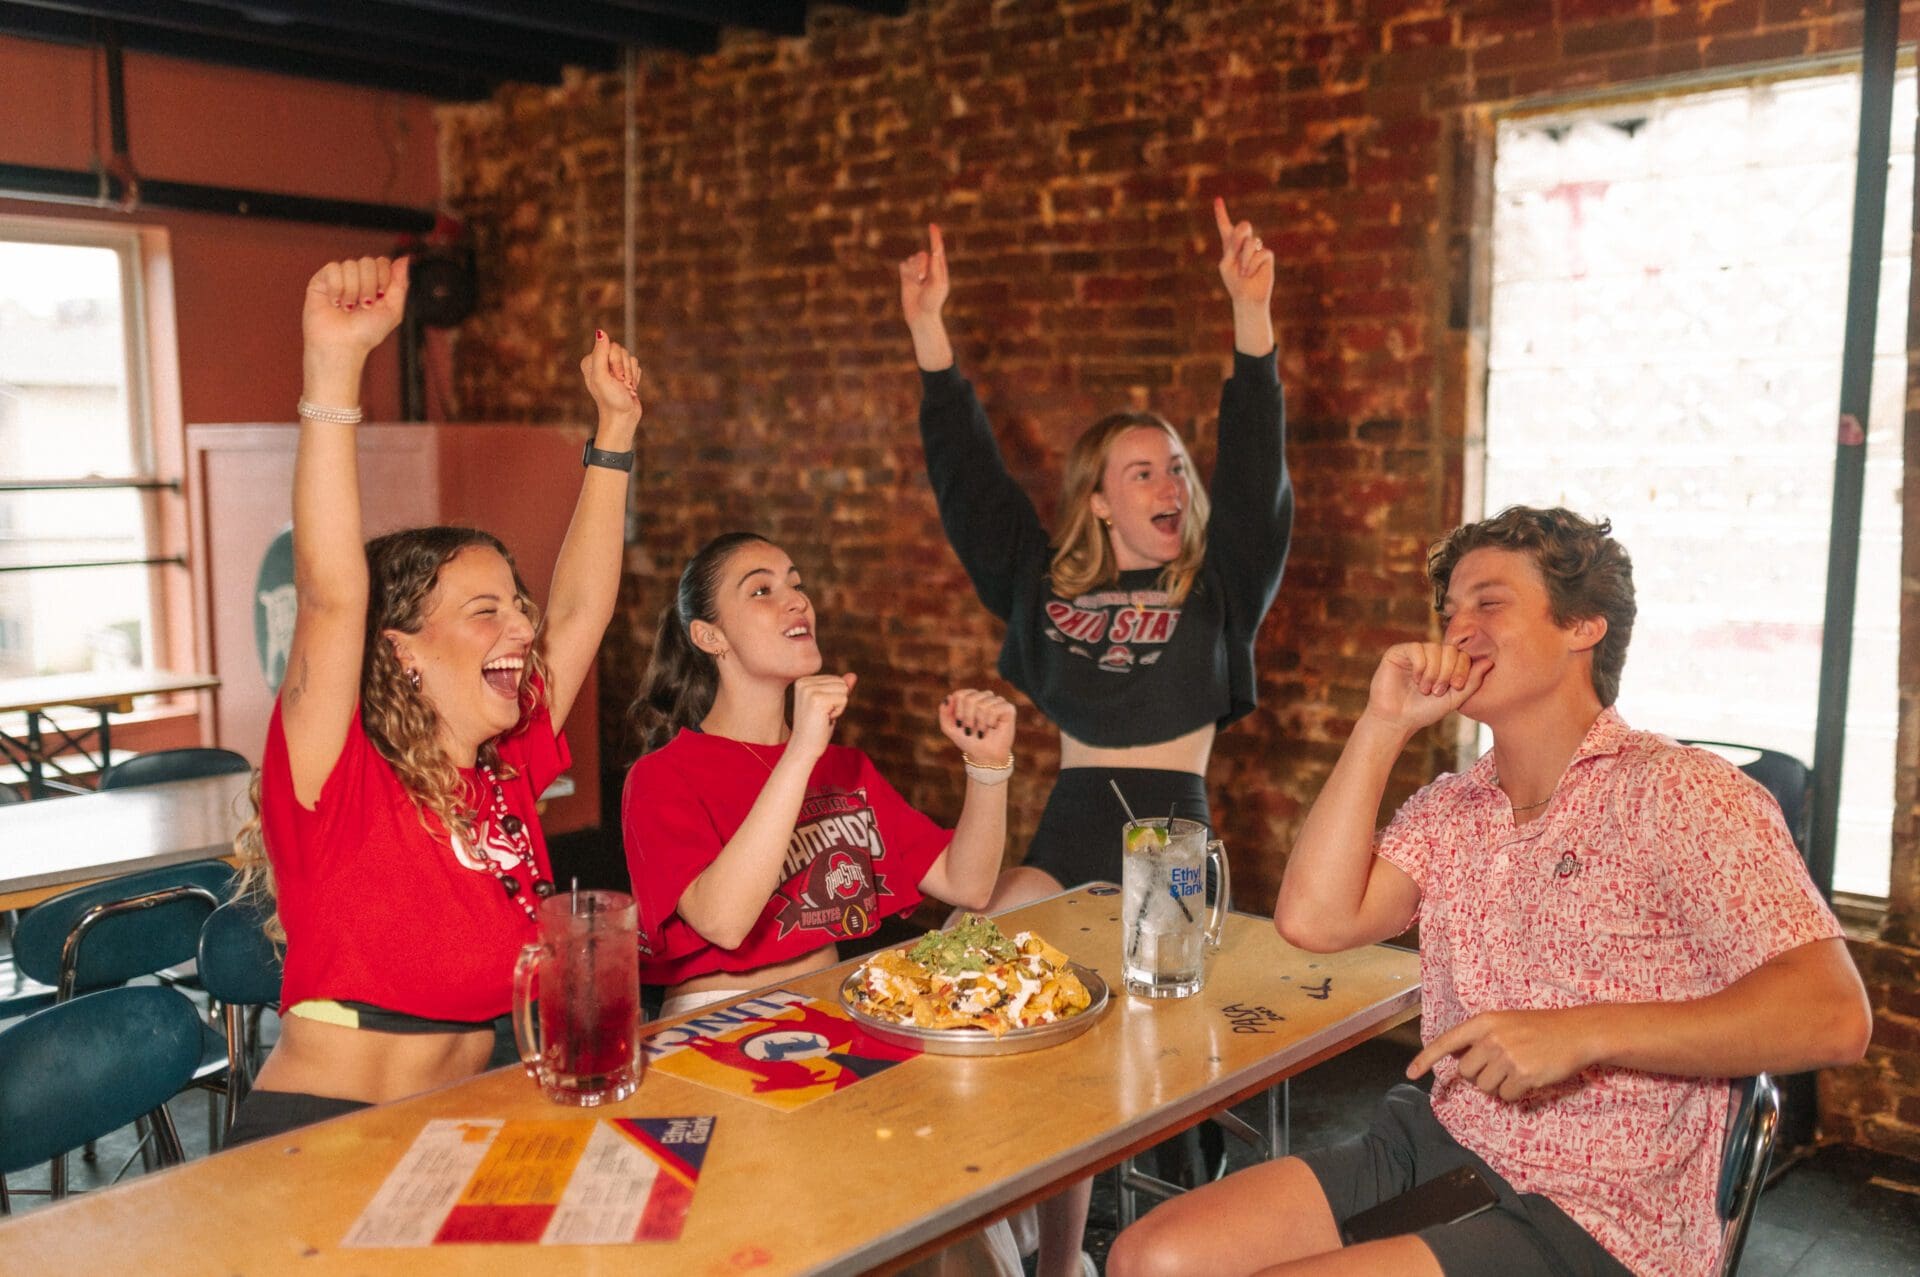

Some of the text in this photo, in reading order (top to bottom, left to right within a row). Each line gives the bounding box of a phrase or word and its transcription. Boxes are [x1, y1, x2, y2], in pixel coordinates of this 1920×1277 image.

[1108, 606, 1181, 644] STA
[1171, 864, 1201, 883] Ethyl
[637, 989, 812, 1055] LUNC
